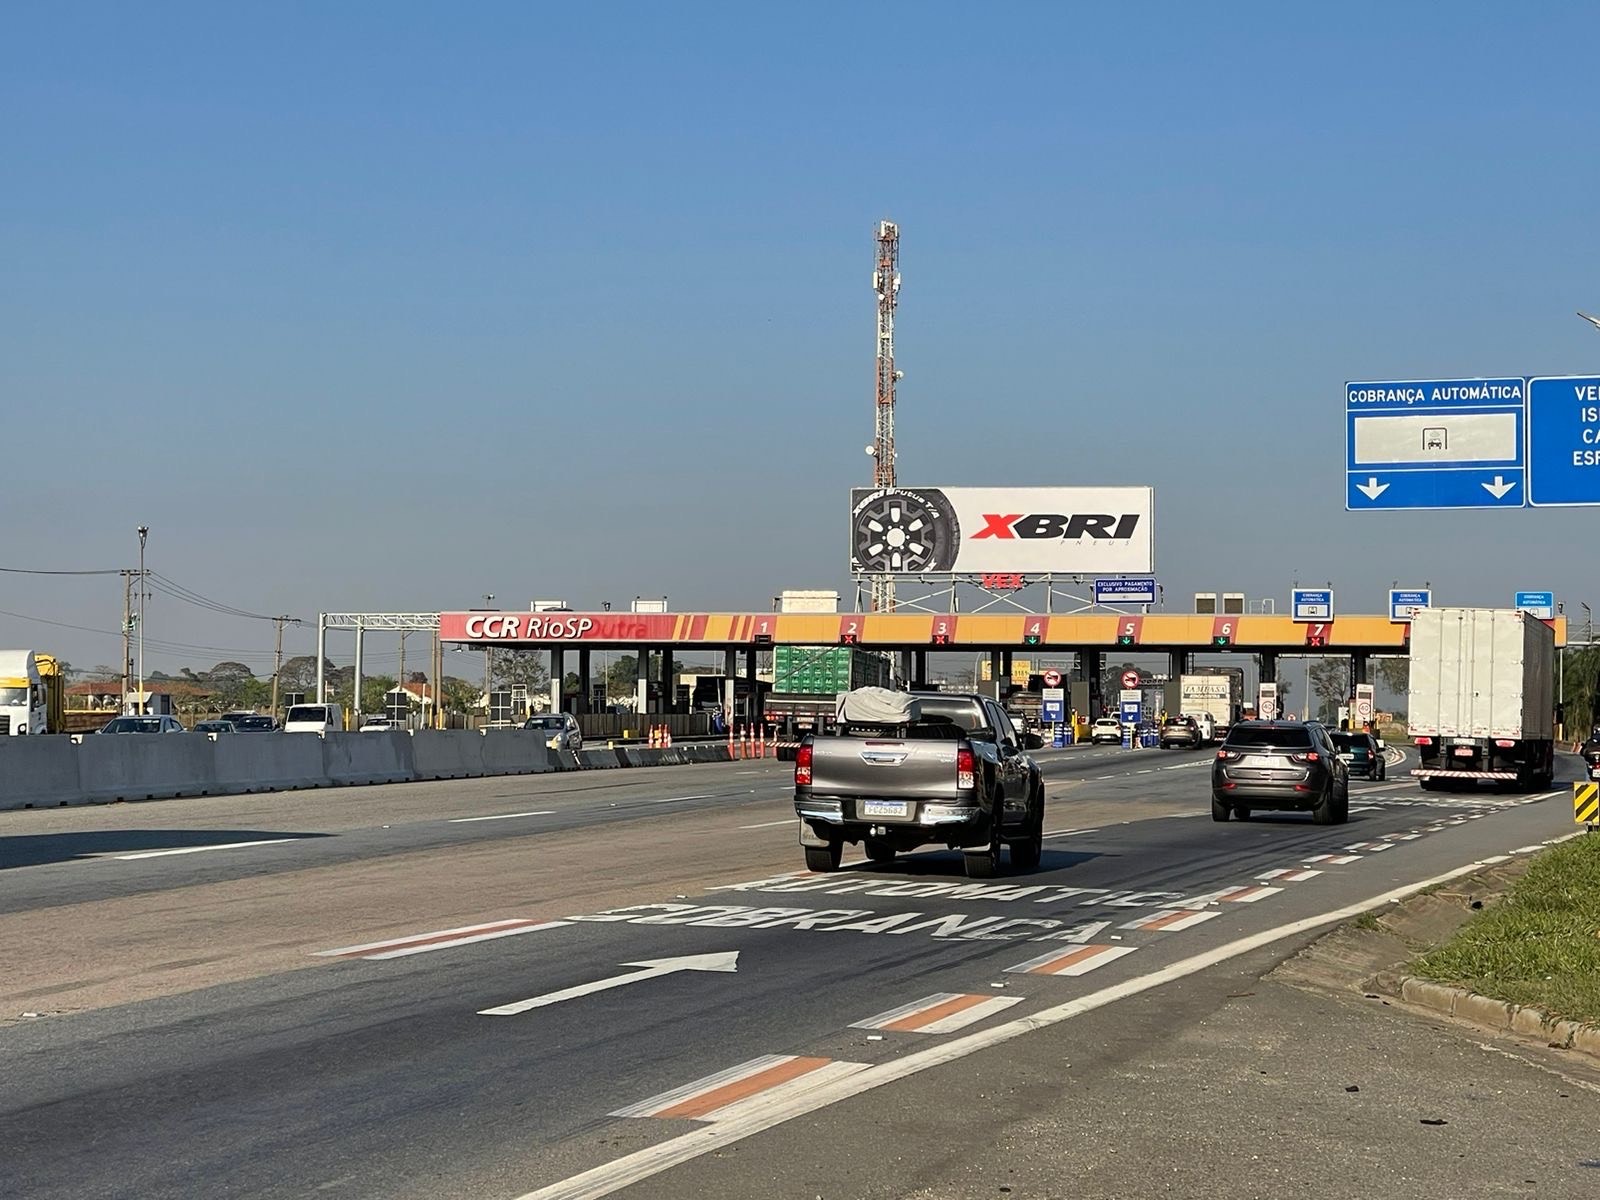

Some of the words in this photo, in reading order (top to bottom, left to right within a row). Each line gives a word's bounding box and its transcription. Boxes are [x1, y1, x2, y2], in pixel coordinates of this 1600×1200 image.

[1349, 388, 1425, 404] COBRANÇA
[1431, 382, 1522, 400] AUTOMÁTICA
[1574, 386, 1600, 401] VE
[1582, 407, 1600, 422] IS
[853, 489, 885, 518] XBRI
[969, 514, 1141, 539] XBRI
[465, 616, 521, 638] CCR
[526, 616, 593, 639] RioSP
[760, 622, 768, 633] 1
[847, 623, 857, 633] 2
[937, 623, 947, 634] 3
[1030, 623, 1040, 634] 4
[1124, 623, 1134, 634] 5
[1221, 623, 1231, 634] 6
[1313, 624, 1324, 635] 7
